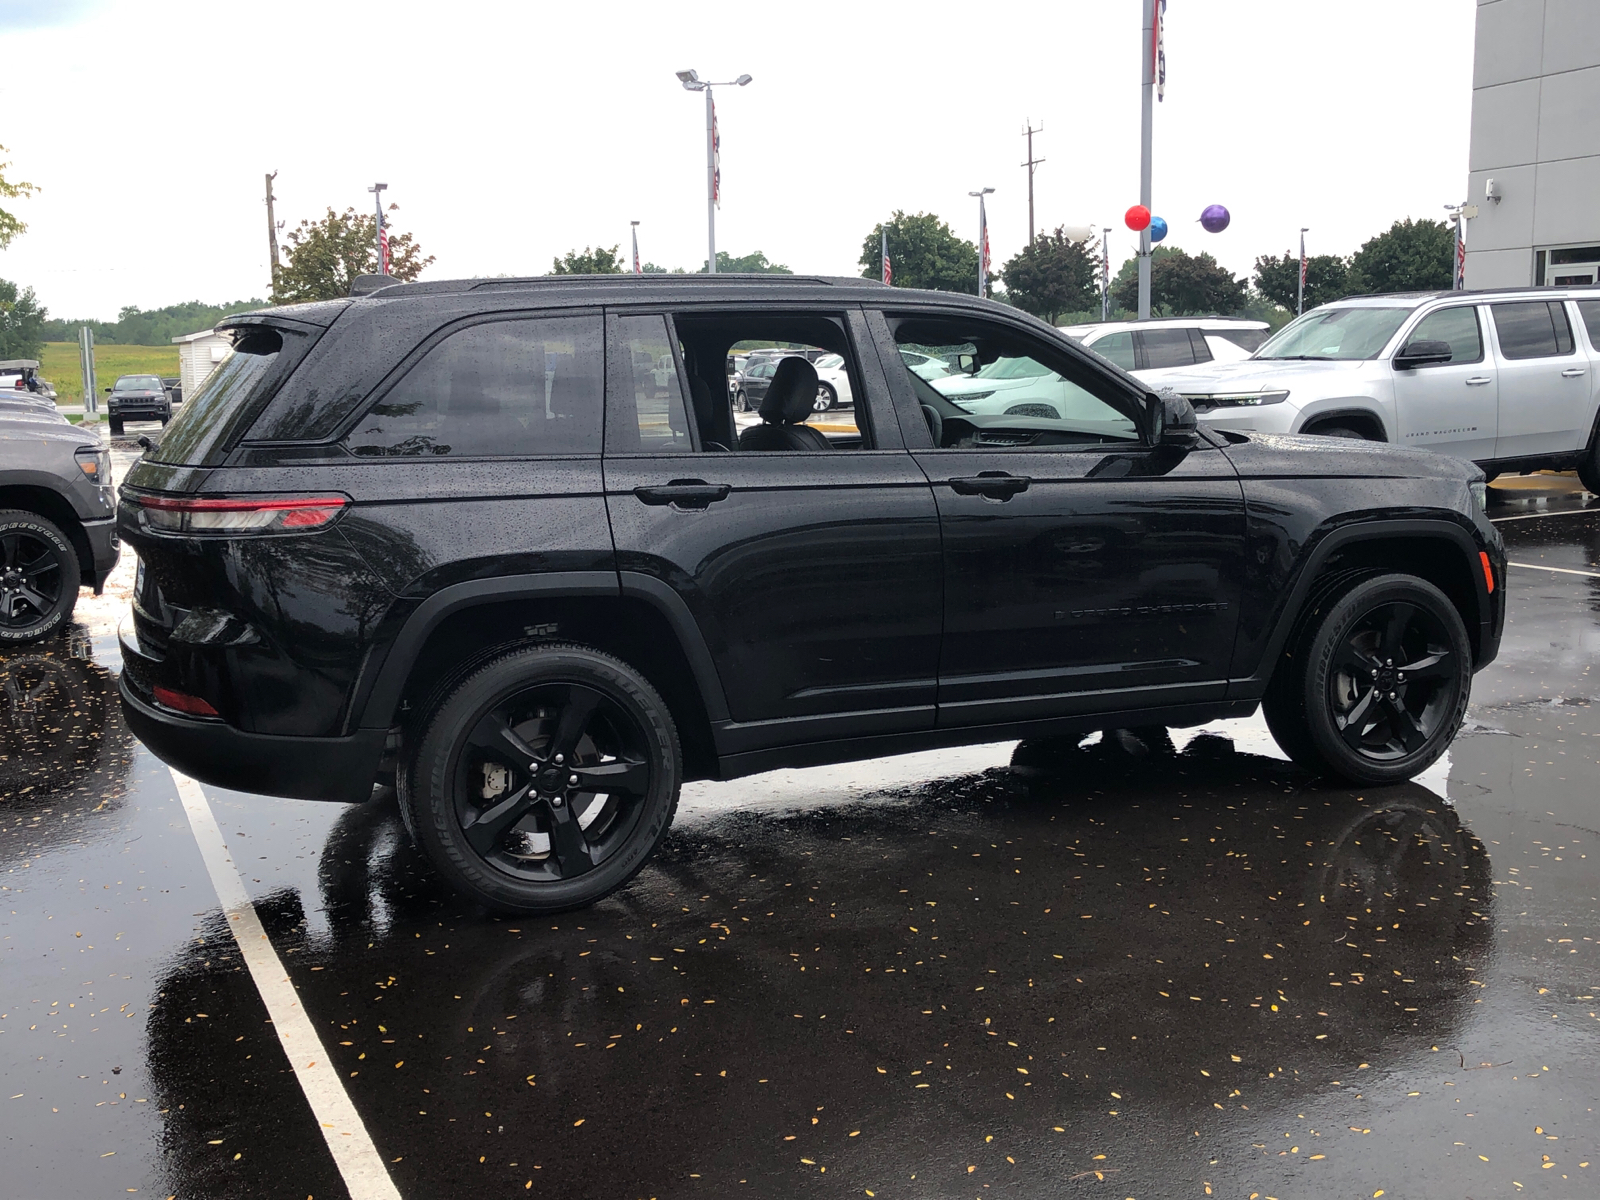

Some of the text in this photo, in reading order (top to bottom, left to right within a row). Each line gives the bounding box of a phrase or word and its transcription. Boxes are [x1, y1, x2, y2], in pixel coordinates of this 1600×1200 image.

[1434, 427, 1471, 435] WAGONEER
[0, 612, 62, 639] DUELER
[594, 667, 671, 771] DUELER
